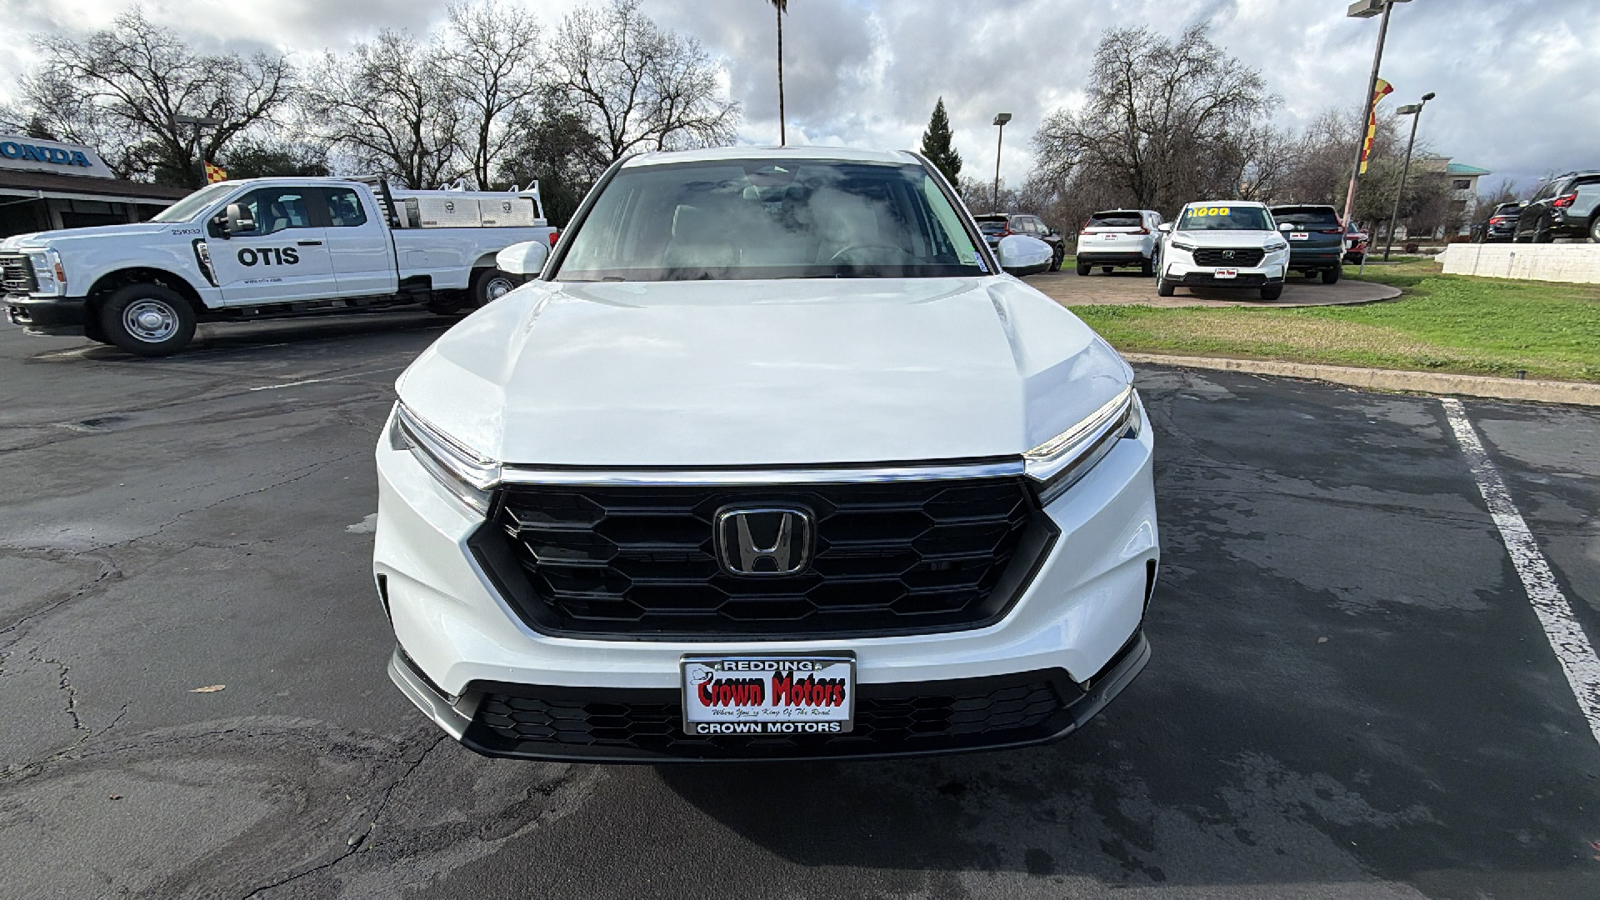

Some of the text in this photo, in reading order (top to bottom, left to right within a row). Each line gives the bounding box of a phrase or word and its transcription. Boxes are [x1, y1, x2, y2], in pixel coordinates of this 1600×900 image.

[0, 141, 93, 168] ONDA
[1187, 207, 1230, 218] $1000
[237, 247, 299, 267] OTIS
[723, 661, 813, 671] REDDING
[697, 671, 846, 707] Crown Motors
[711, 708, 735, 716] Where
[762, 708, 781, 717] King
[783, 708, 792, 717] Of
[795, 708, 808, 716] The
[696, 721, 841, 734] CROWN MOTORS
